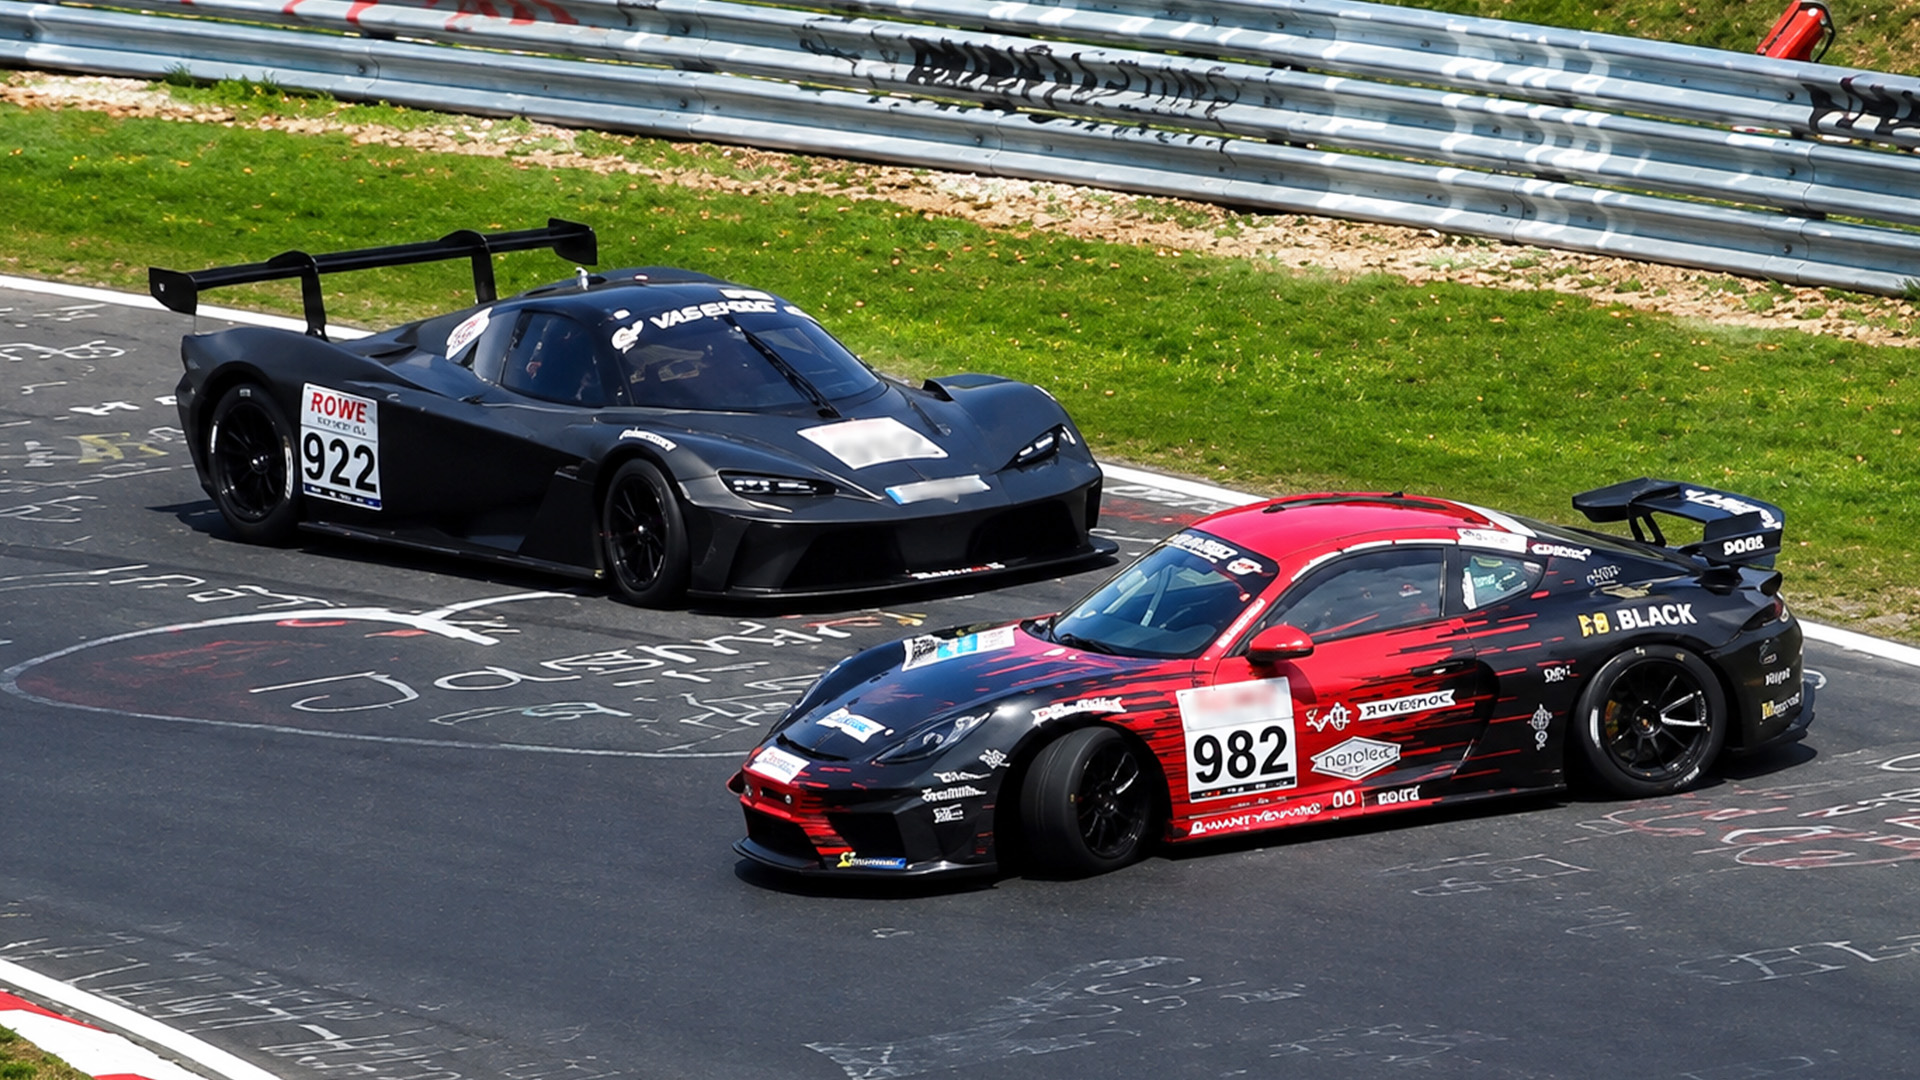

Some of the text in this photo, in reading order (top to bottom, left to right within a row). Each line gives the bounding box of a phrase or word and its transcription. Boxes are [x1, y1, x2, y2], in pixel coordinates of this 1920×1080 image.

[311, 392, 367, 424] ROWE
[303, 432, 378, 494] 922
[1193, 725, 1289, 784] 982
